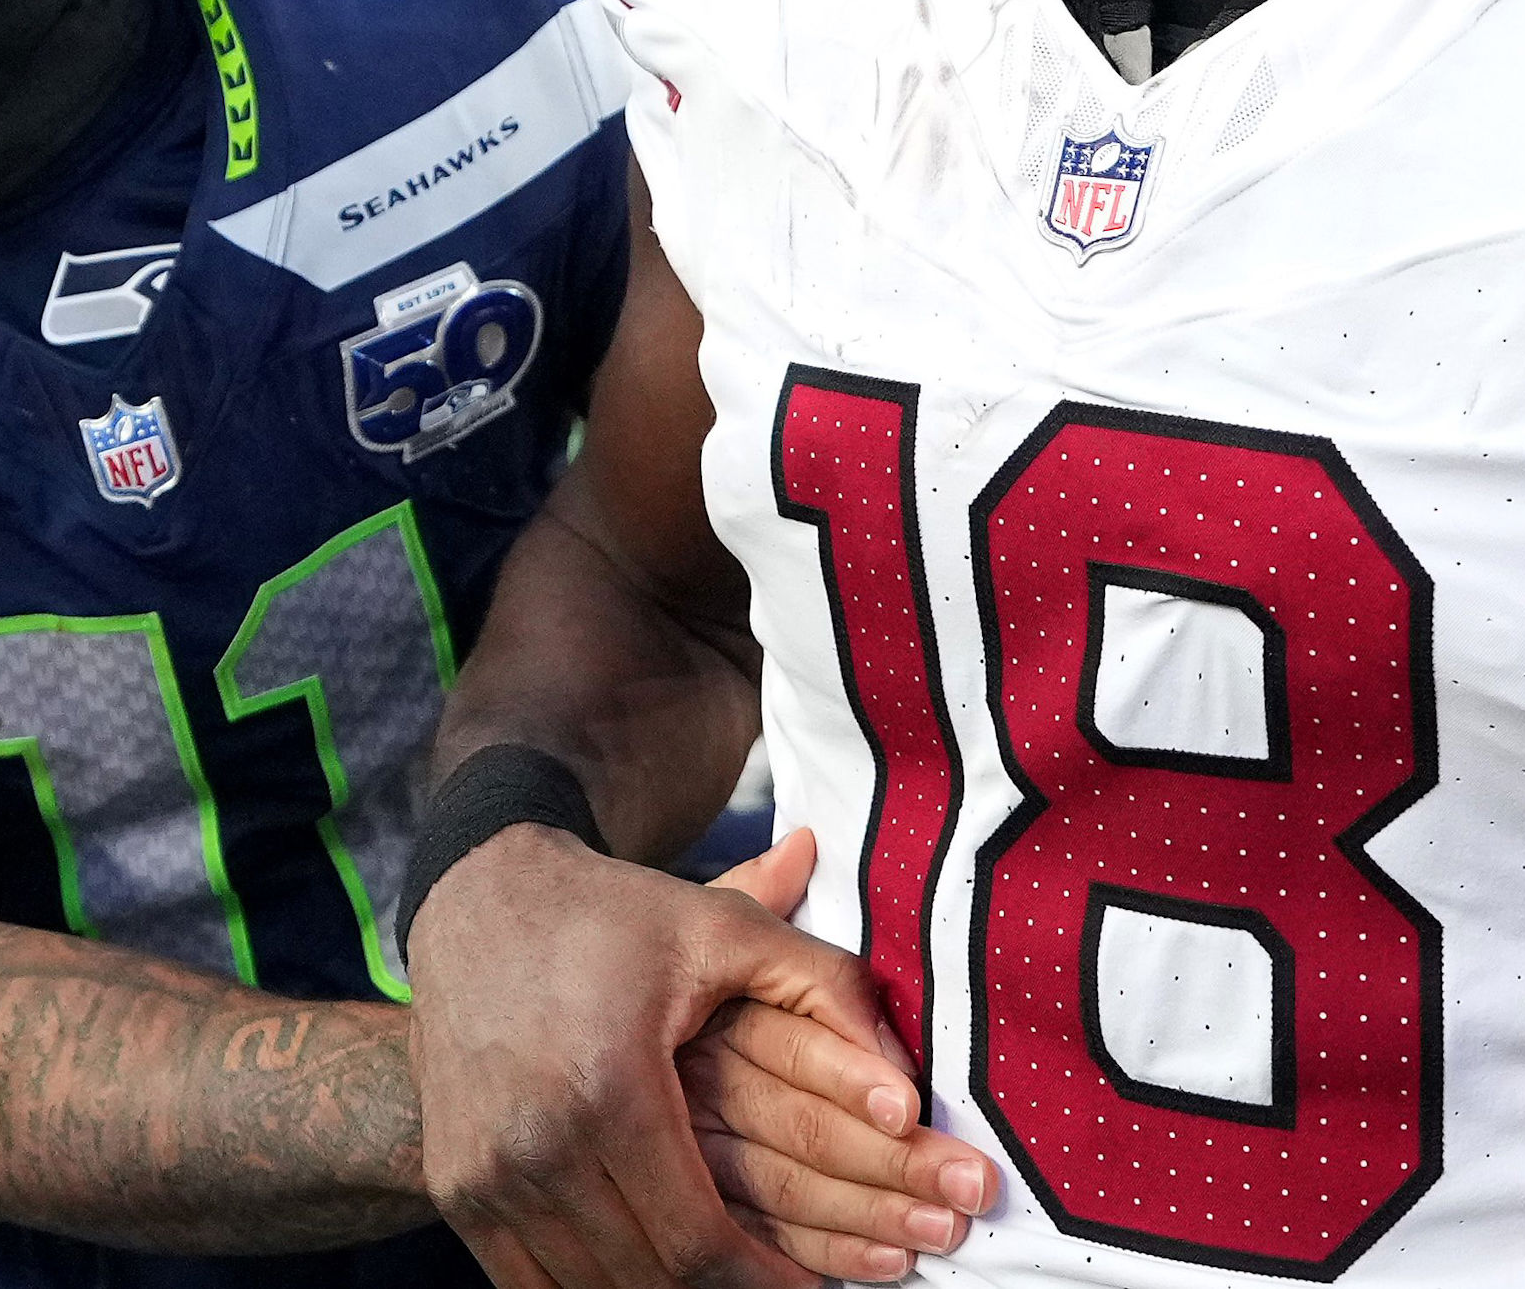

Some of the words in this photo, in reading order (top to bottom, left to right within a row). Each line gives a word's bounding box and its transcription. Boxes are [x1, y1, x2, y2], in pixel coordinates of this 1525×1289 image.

[338, 116, 521, 232] SEAHAWKS
[1055, 179, 1127, 237] NFL
[347, 286, 538, 446] 50
[105, 444, 168, 487] NFL
[770, 361, 1445, 1284] 18
